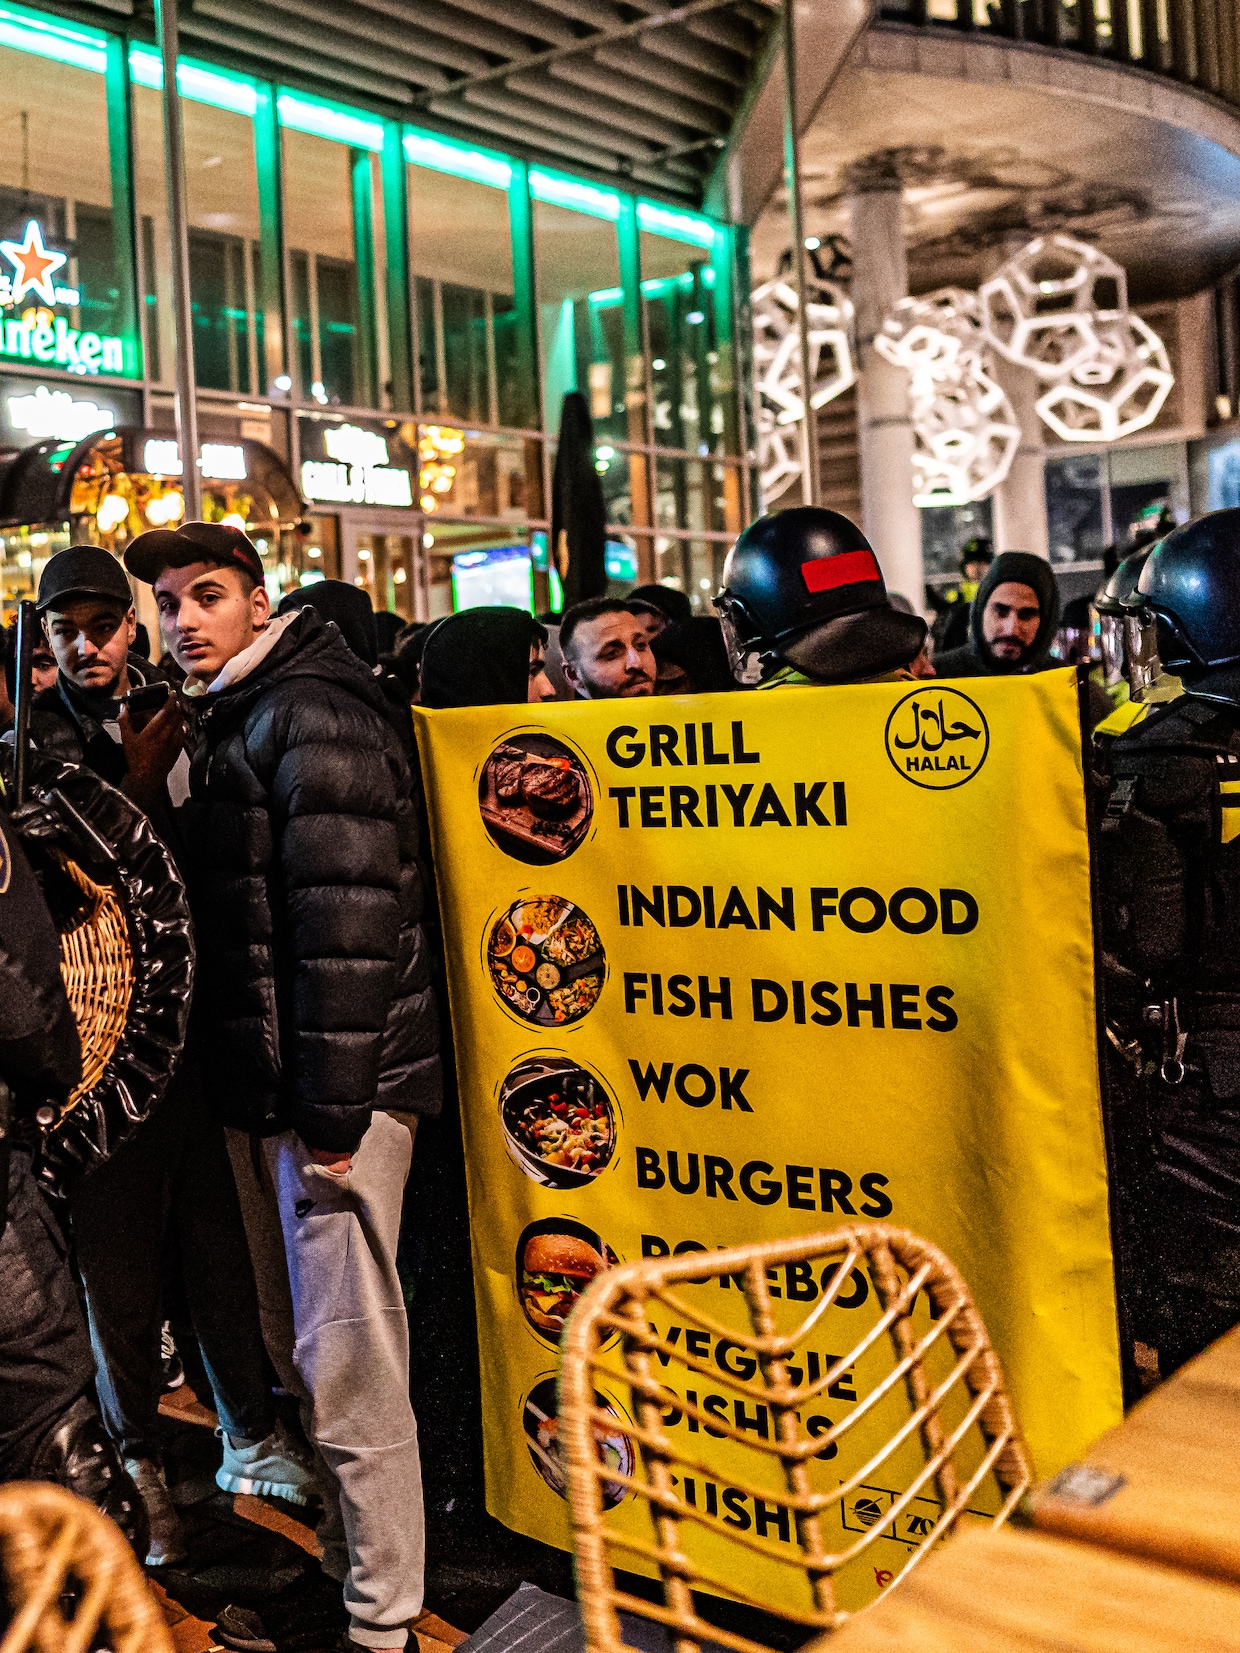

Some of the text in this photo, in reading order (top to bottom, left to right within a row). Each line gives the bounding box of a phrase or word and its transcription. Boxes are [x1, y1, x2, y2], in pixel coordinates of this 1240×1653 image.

[606, 720, 760, 769] GRILL
[894, 698, 982, 752] حلال
[905, 755, 972, 772] HALAL
[608, 781, 848, 829] TERIYAKI
[617, 884, 979, 936] INDIAN FOOD
[623, 971, 959, 1033] FISH DISHES
[627, 1058, 755, 1113] WOK
[635, 1146, 893, 1219] BURGERS
[656, 1384, 839, 1461] DISHS
[670, 1473, 806, 1546] USHI
